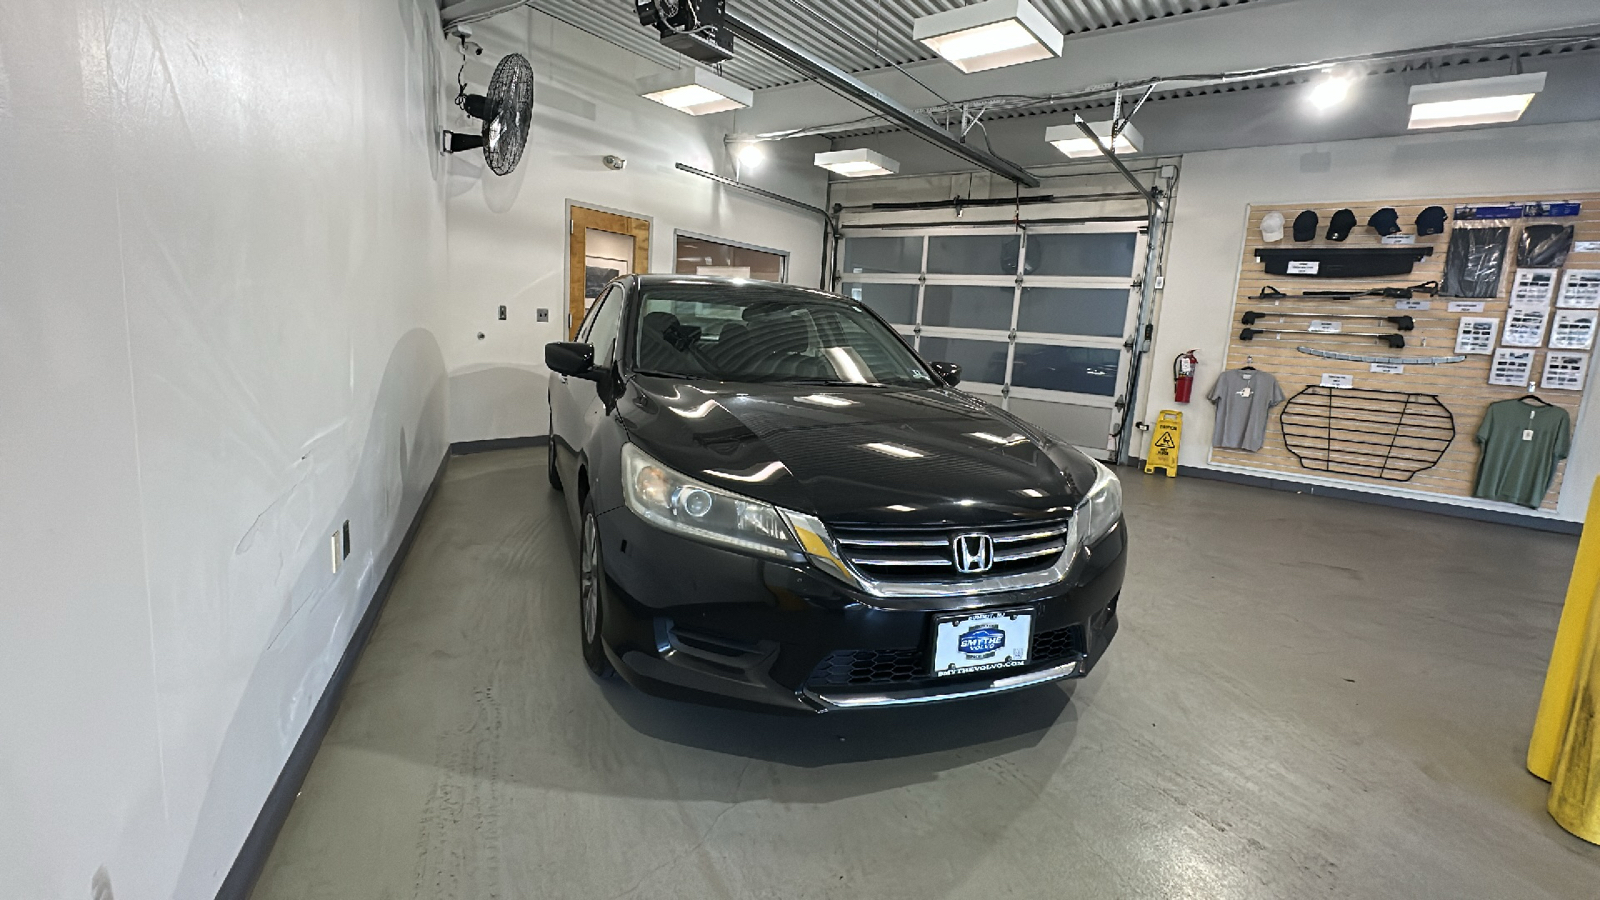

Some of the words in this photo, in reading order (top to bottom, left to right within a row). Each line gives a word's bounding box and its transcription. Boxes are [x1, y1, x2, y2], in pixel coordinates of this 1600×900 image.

[960, 636, 1003, 647] SMYTHE
[969, 643, 995, 651] VOLVO
[937, 661, 1025, 677] SMYTHEVOLVO.COM
